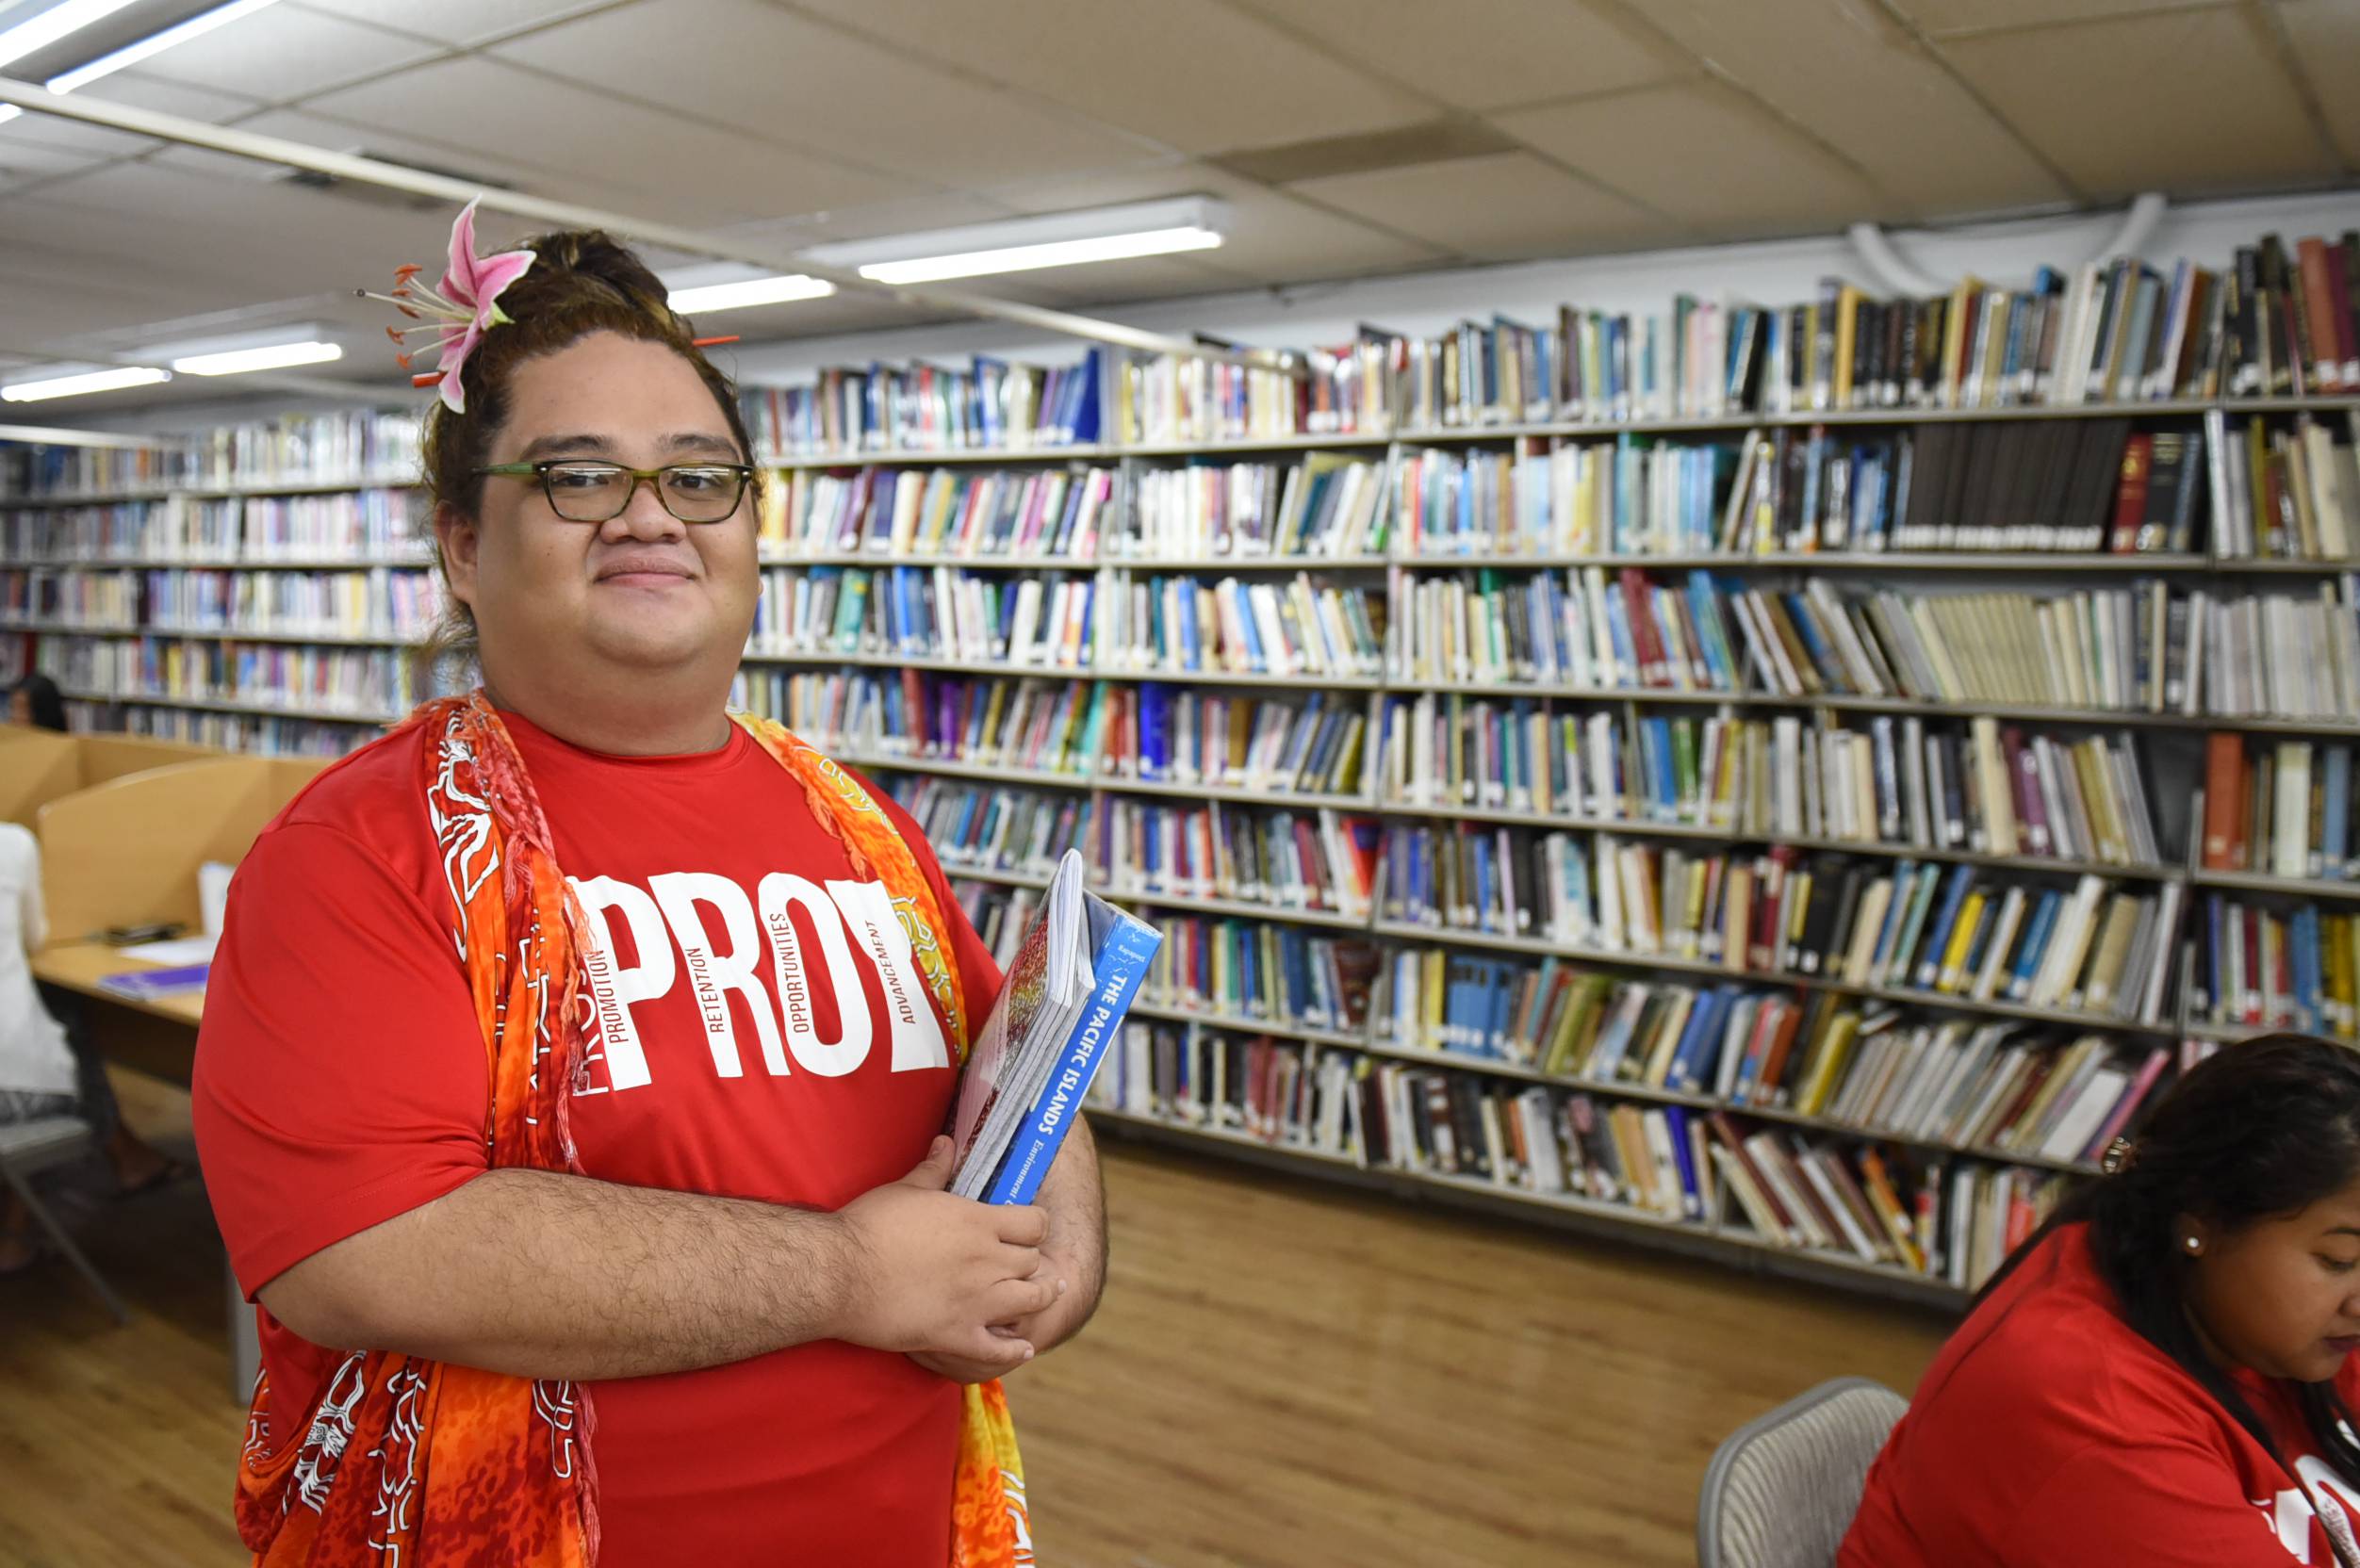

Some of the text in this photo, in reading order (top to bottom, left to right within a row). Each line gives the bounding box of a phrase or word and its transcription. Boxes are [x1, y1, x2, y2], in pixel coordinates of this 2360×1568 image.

[585, 950, 630, 1044] PROMOTION
[685, 947, 725, 1033] RETENTION
[769, 913, 810, 1034] OPPORTUNITIES
[864, 920, 916, 1024] ADVANCEMENT
[1009, 974, 1128, 1199] THE PACIFIC ISLANDS Environment
